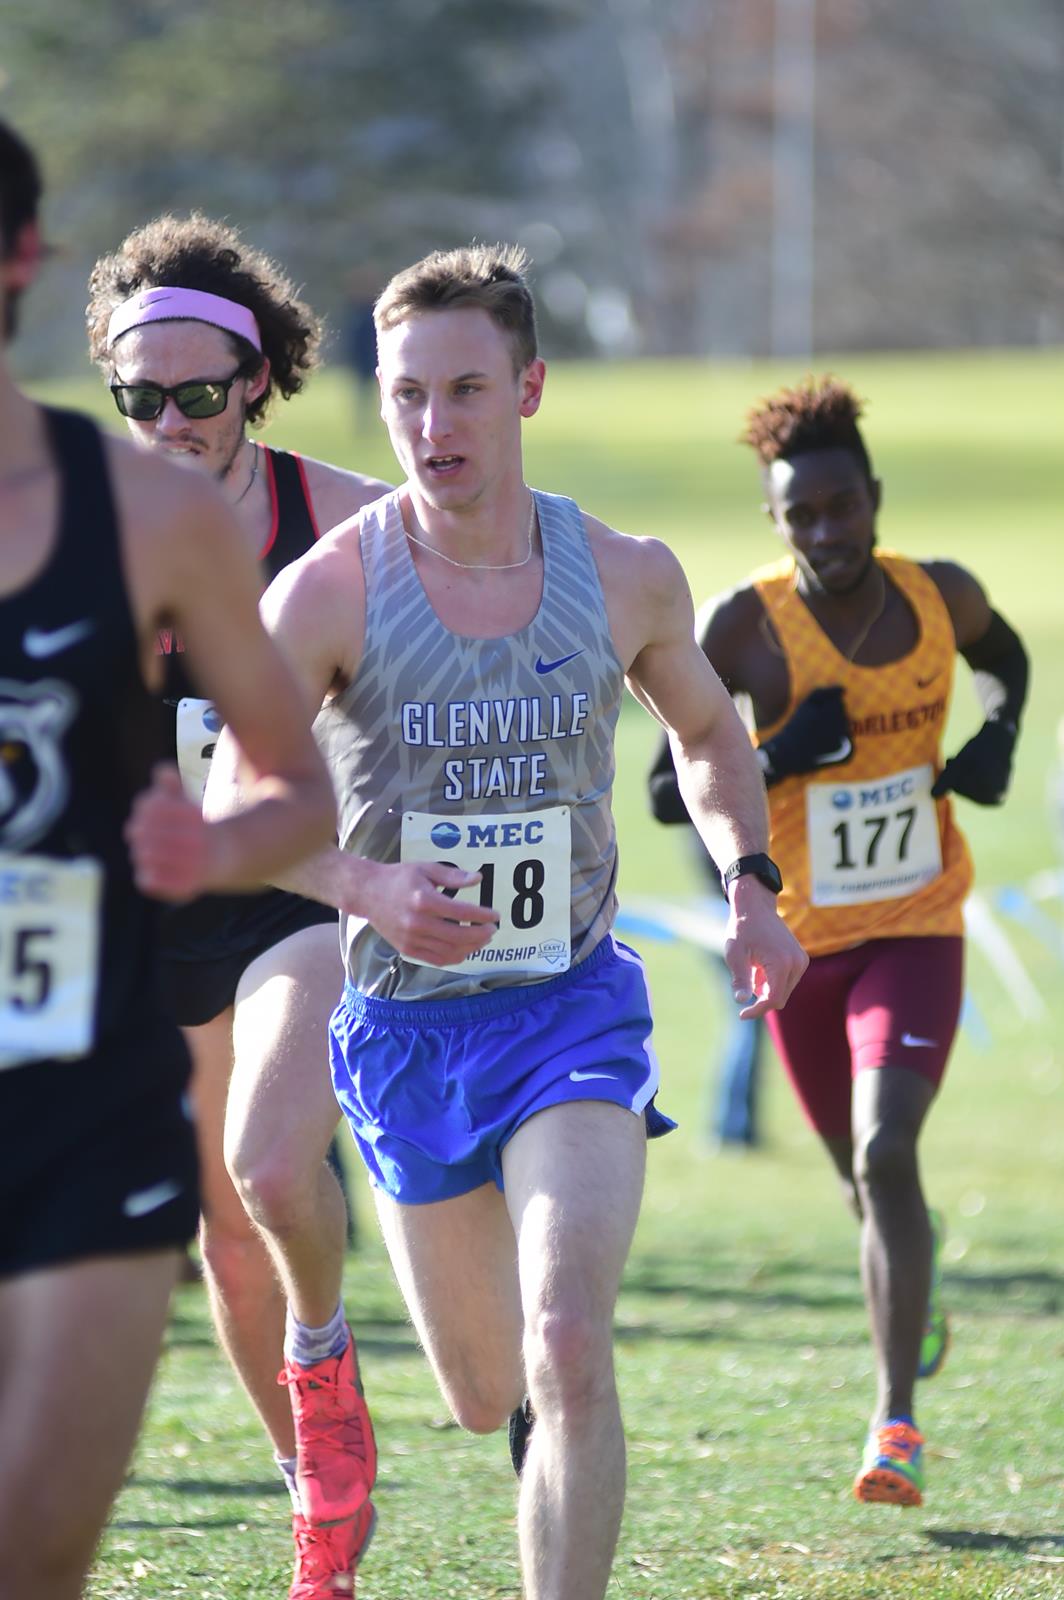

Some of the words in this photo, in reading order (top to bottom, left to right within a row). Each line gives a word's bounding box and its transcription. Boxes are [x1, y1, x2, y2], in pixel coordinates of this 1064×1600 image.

[402, 692, 588, 747] GLENVILLE
[444, 753, 547, 800] STATE
[859, 778, 913, 808] MEC
[466, 820, 544, 848] MEC
[831, 806, 917, 870] 177
[0, 926, 57, 1017] 5
